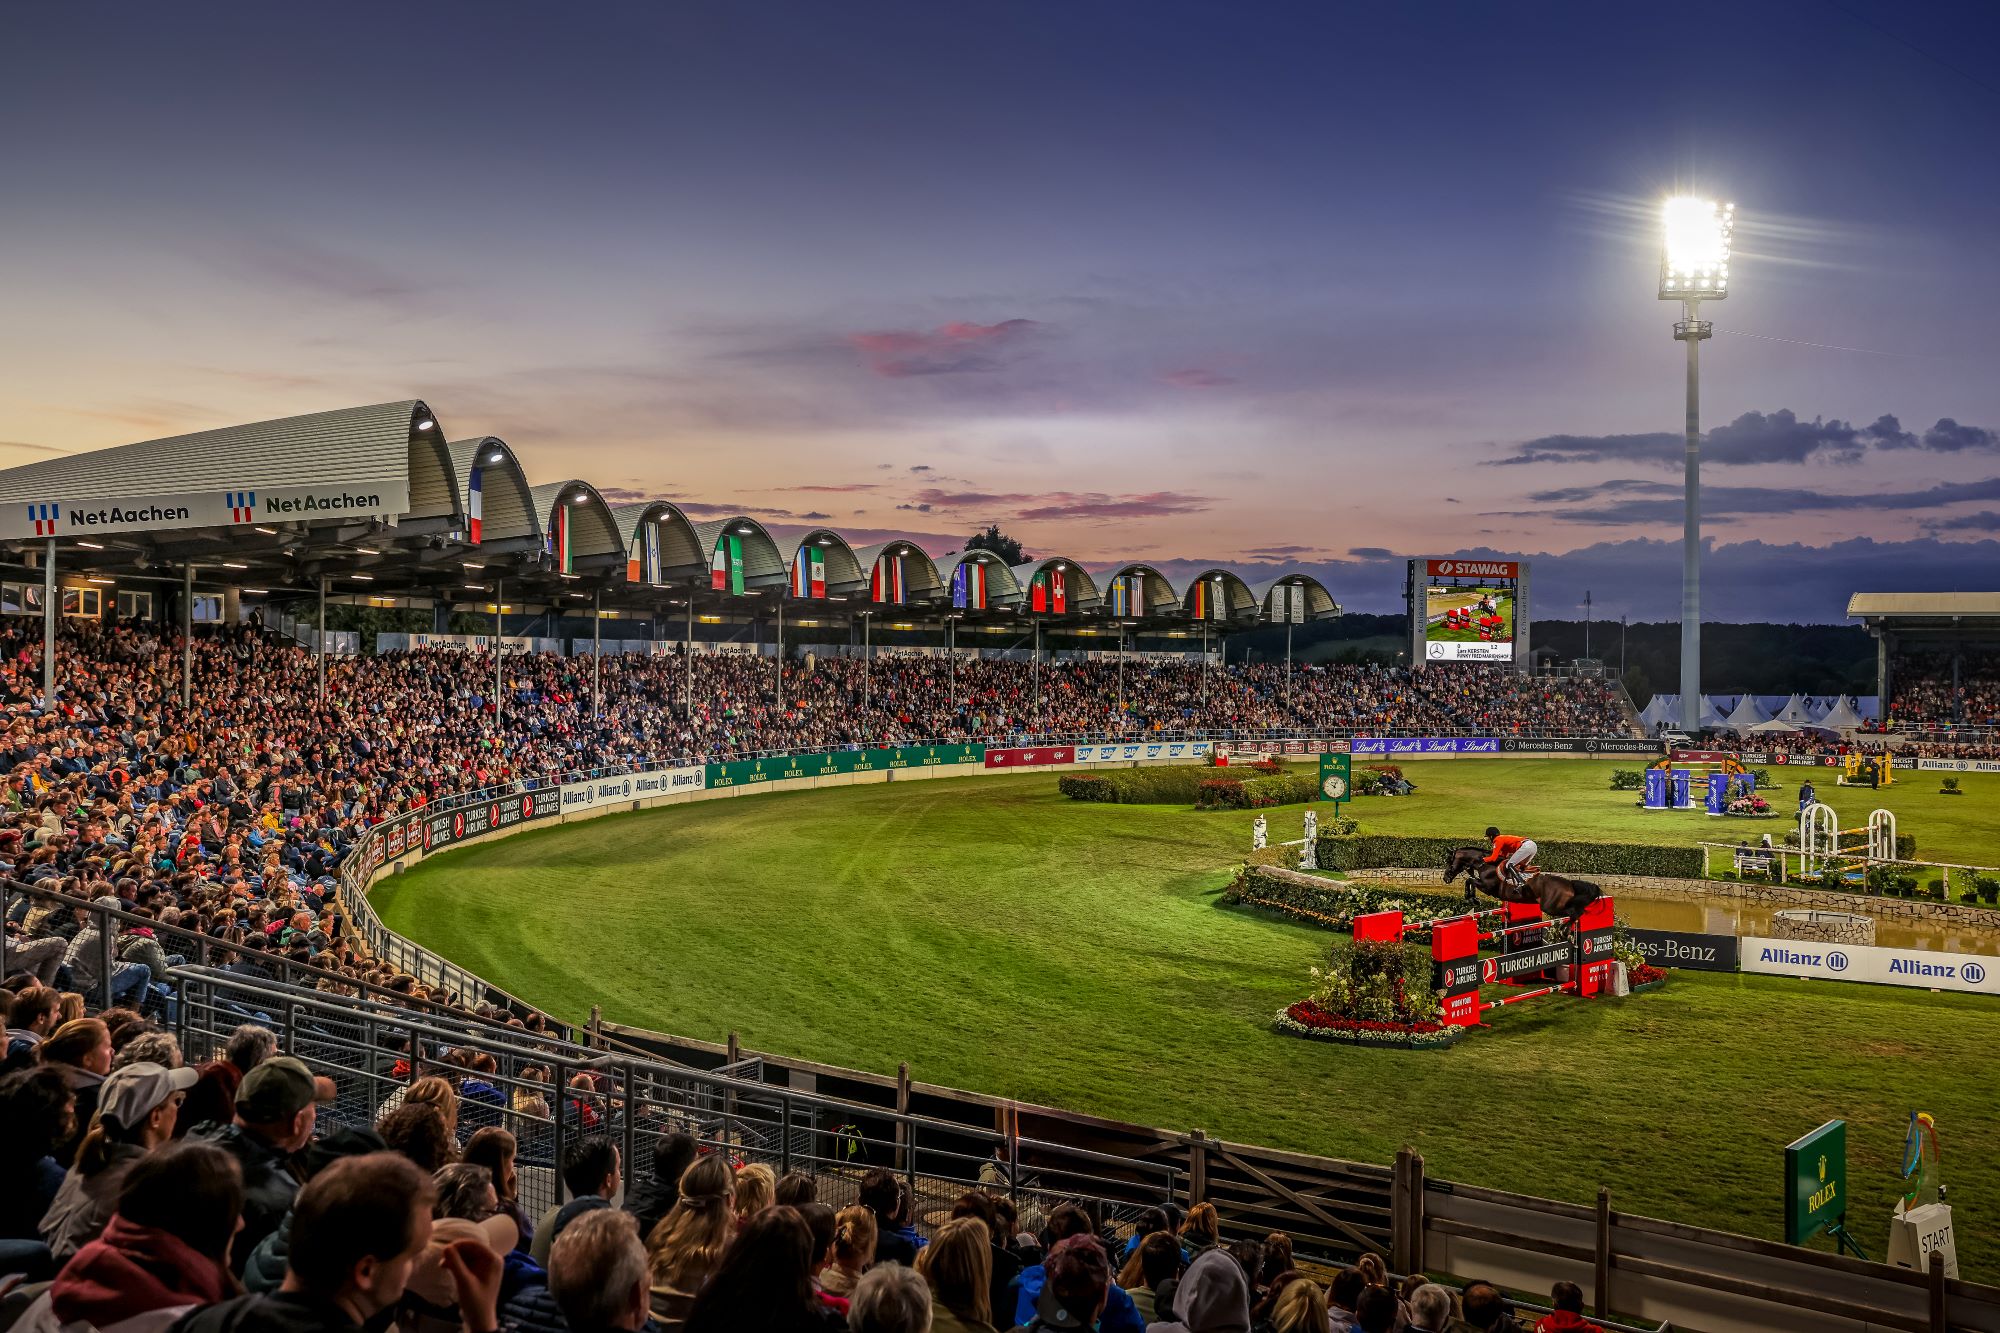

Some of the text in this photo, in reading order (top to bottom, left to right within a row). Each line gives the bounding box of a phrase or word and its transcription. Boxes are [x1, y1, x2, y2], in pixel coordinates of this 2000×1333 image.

[265, 492, 380, 514] NetAachen
[70, 505, 189, 526] NetAachen
[1455, 562, 1508, 576] STAWAG
[488, 640, 525, 650] NeAachen
[1354, 741, 1378, 752] Lindt
[1390, 741, 1414, 752] Lindt
[1426, 741, 1451, 752] Lindt
[1462, 741, 1490, 752] Lindt
[1518, 741, 1573, 750] Mercedes-Benz
[1600, 742, 1658, 751] Mercedes-Benz
[889, 760, 908, 768] ROLEX
[923, 757, 941, 765] ROLEX
[958, 755, 977, 763] ROLEX
[1921, 760, 1954, 769] Allianz
[820, 766, 838, 774] ROLEX
[853, 762, 873, 771] ROLEX
[749, 772, 767, 782] ROLEX
[784, 769, 803, 777] ROLEX
[636, 779, 659, 792] Allianz
[672, 774, 693, 786] Allianz
[714, 777, 733, 786] ROLEX
[534, 791, 559, 804] TURKISH
[598, 785, 621, 798] Allianz
[562, 792, 585, 805] Allianz
[500, 799, 520, 812] TURKISH
[534, 802, 559, 815] AIRLINES
[465, 807, 487, 821] TURKISH
[500, 810, 520, 823] AIRLINES
[431, 816, 450, 831] TURKISH
[465, 819, 487, 834] AIRLINES
[431, 829, 451, 846] AIRLINES
[1593, 934, 1613, 945] TURKISH
[1593, 942, 1613, 953] AIRLINES
[1500, 947, 1569, 974] TURKISH AIRLINES
[1760, 947, 1822, 967] Allianz
[1455, 964, 1477, 976] TURKISH
[1889, 958, 1956, 978] Allianz
[1455, 973, 1477, 985] AIRLINES
[1808, 1181, 1836, 1214] ROLEX
[1921, 1226, 1950, 1254] START
